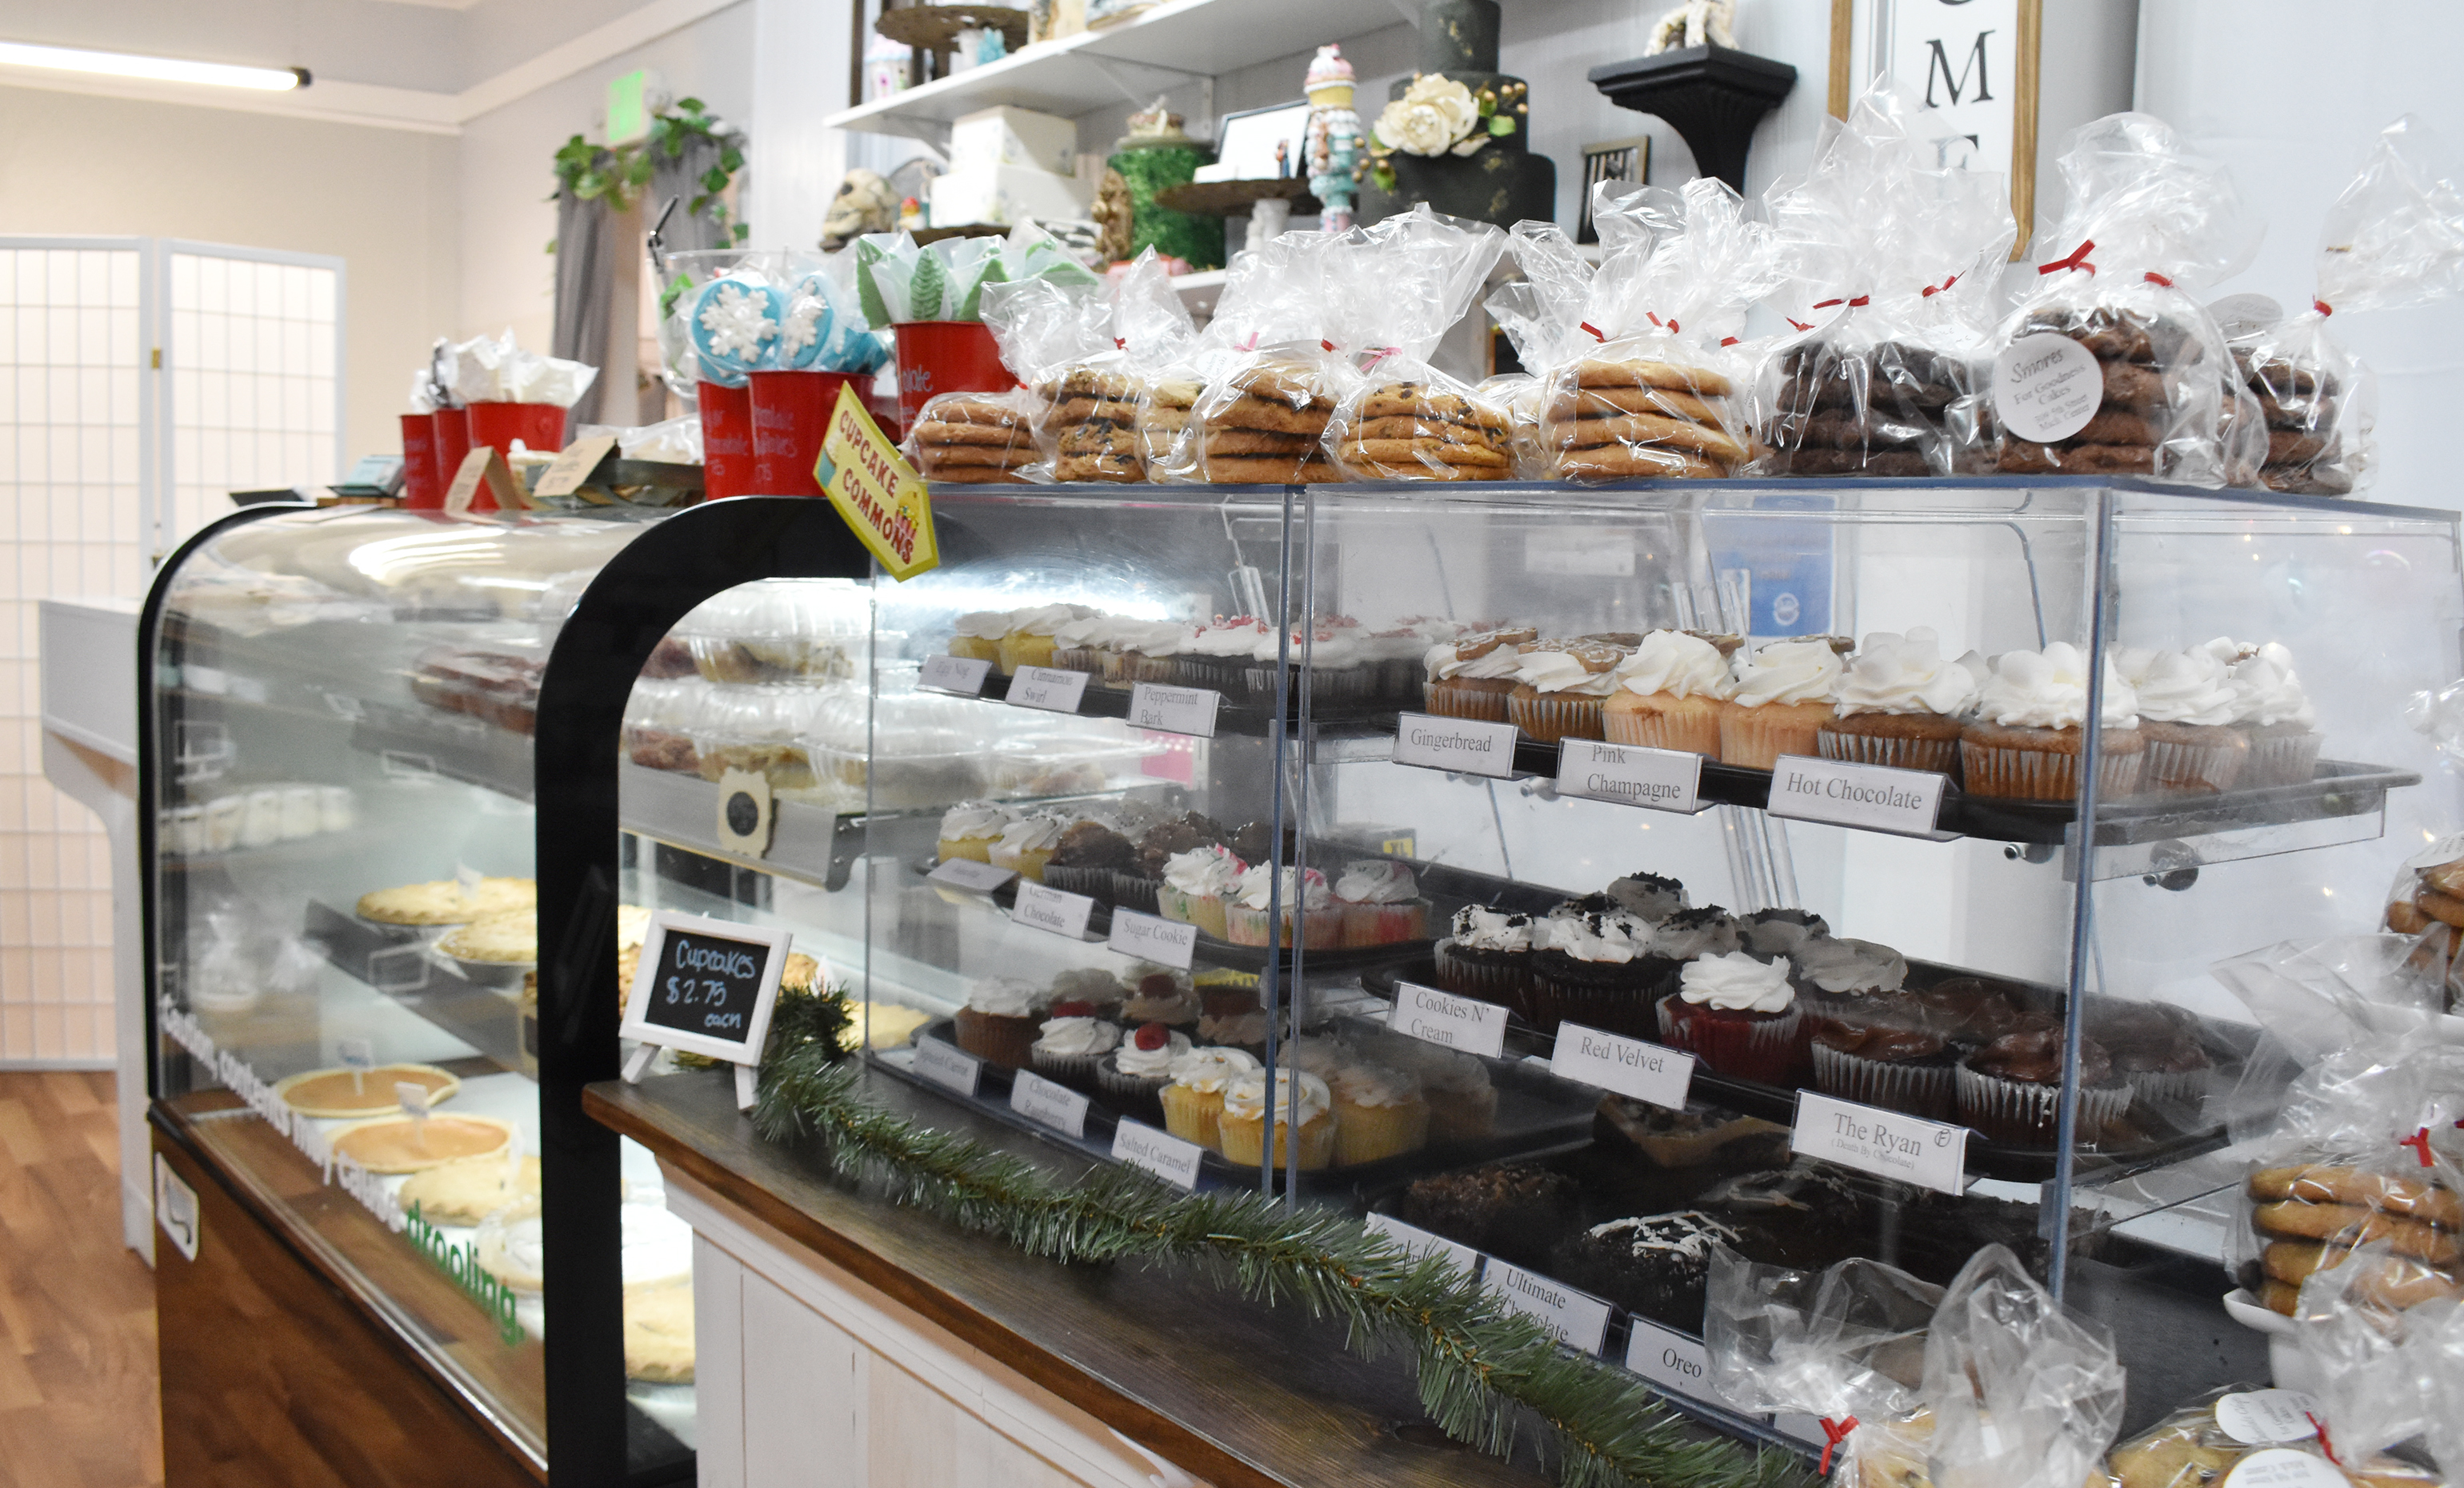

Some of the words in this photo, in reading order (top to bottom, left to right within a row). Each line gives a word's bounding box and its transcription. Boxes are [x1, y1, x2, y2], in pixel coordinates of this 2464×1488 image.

[2011, 350, 2063, 382] Smores
[2014, 390, 2033, 405] For
[2034, 363, 2086, 394] Goodness
[2038, 386, 2072, 405] Cakes
[838, 410, 899, 499] CUPCAKE
[843, 468, 914, 565] COMMONS
[1030, 666, 1074, 686] Cinnamon
[1023, 686, 1047, 703] Swirl
[1144, 686, 1198, 706] Peppermint
[1140, 709, 1164, 726] Bark
[1411, 728, 1492, 752] Gingerbread
[1591, 744, 1626, 765] Pink
[1586, 772, 1681, 801] Champagne
[1786, 771, 1822, 795] Hot
[1826, 777, 1922, 811] Chocolate
[1023, 904, 1066, 929] Chocolate
[1123, 918, 1150, 942] Sugar
[1152, 925, 1189, 946] Cookie
[675, 938, 756, 979] Cupcakes
[666, 975, 728, 1006] $2.75
[1414, 990, 1468, 1021] Cookies
[1410, 1022, 1454, 1046] Cream
[1580, 1035, 1614, 1060] Red
[1617, 1042, 1665, 1074] Velvet
[1030, 1078, 1072, 1106] Chocolate
[1833, 1112, 1868, 1142] The
[1872, 1123, 1922, 1157] Ryan
[1118, 1132, 1148, 1157] Salted
[1150, 1146, 1192, 1174] Caramel
[1506, 1268, 1566, 1310] Ultimate
[1502, 1295, 1569, 1343] Cholate
[1662, 1348, 1702, 1379] Oreo
